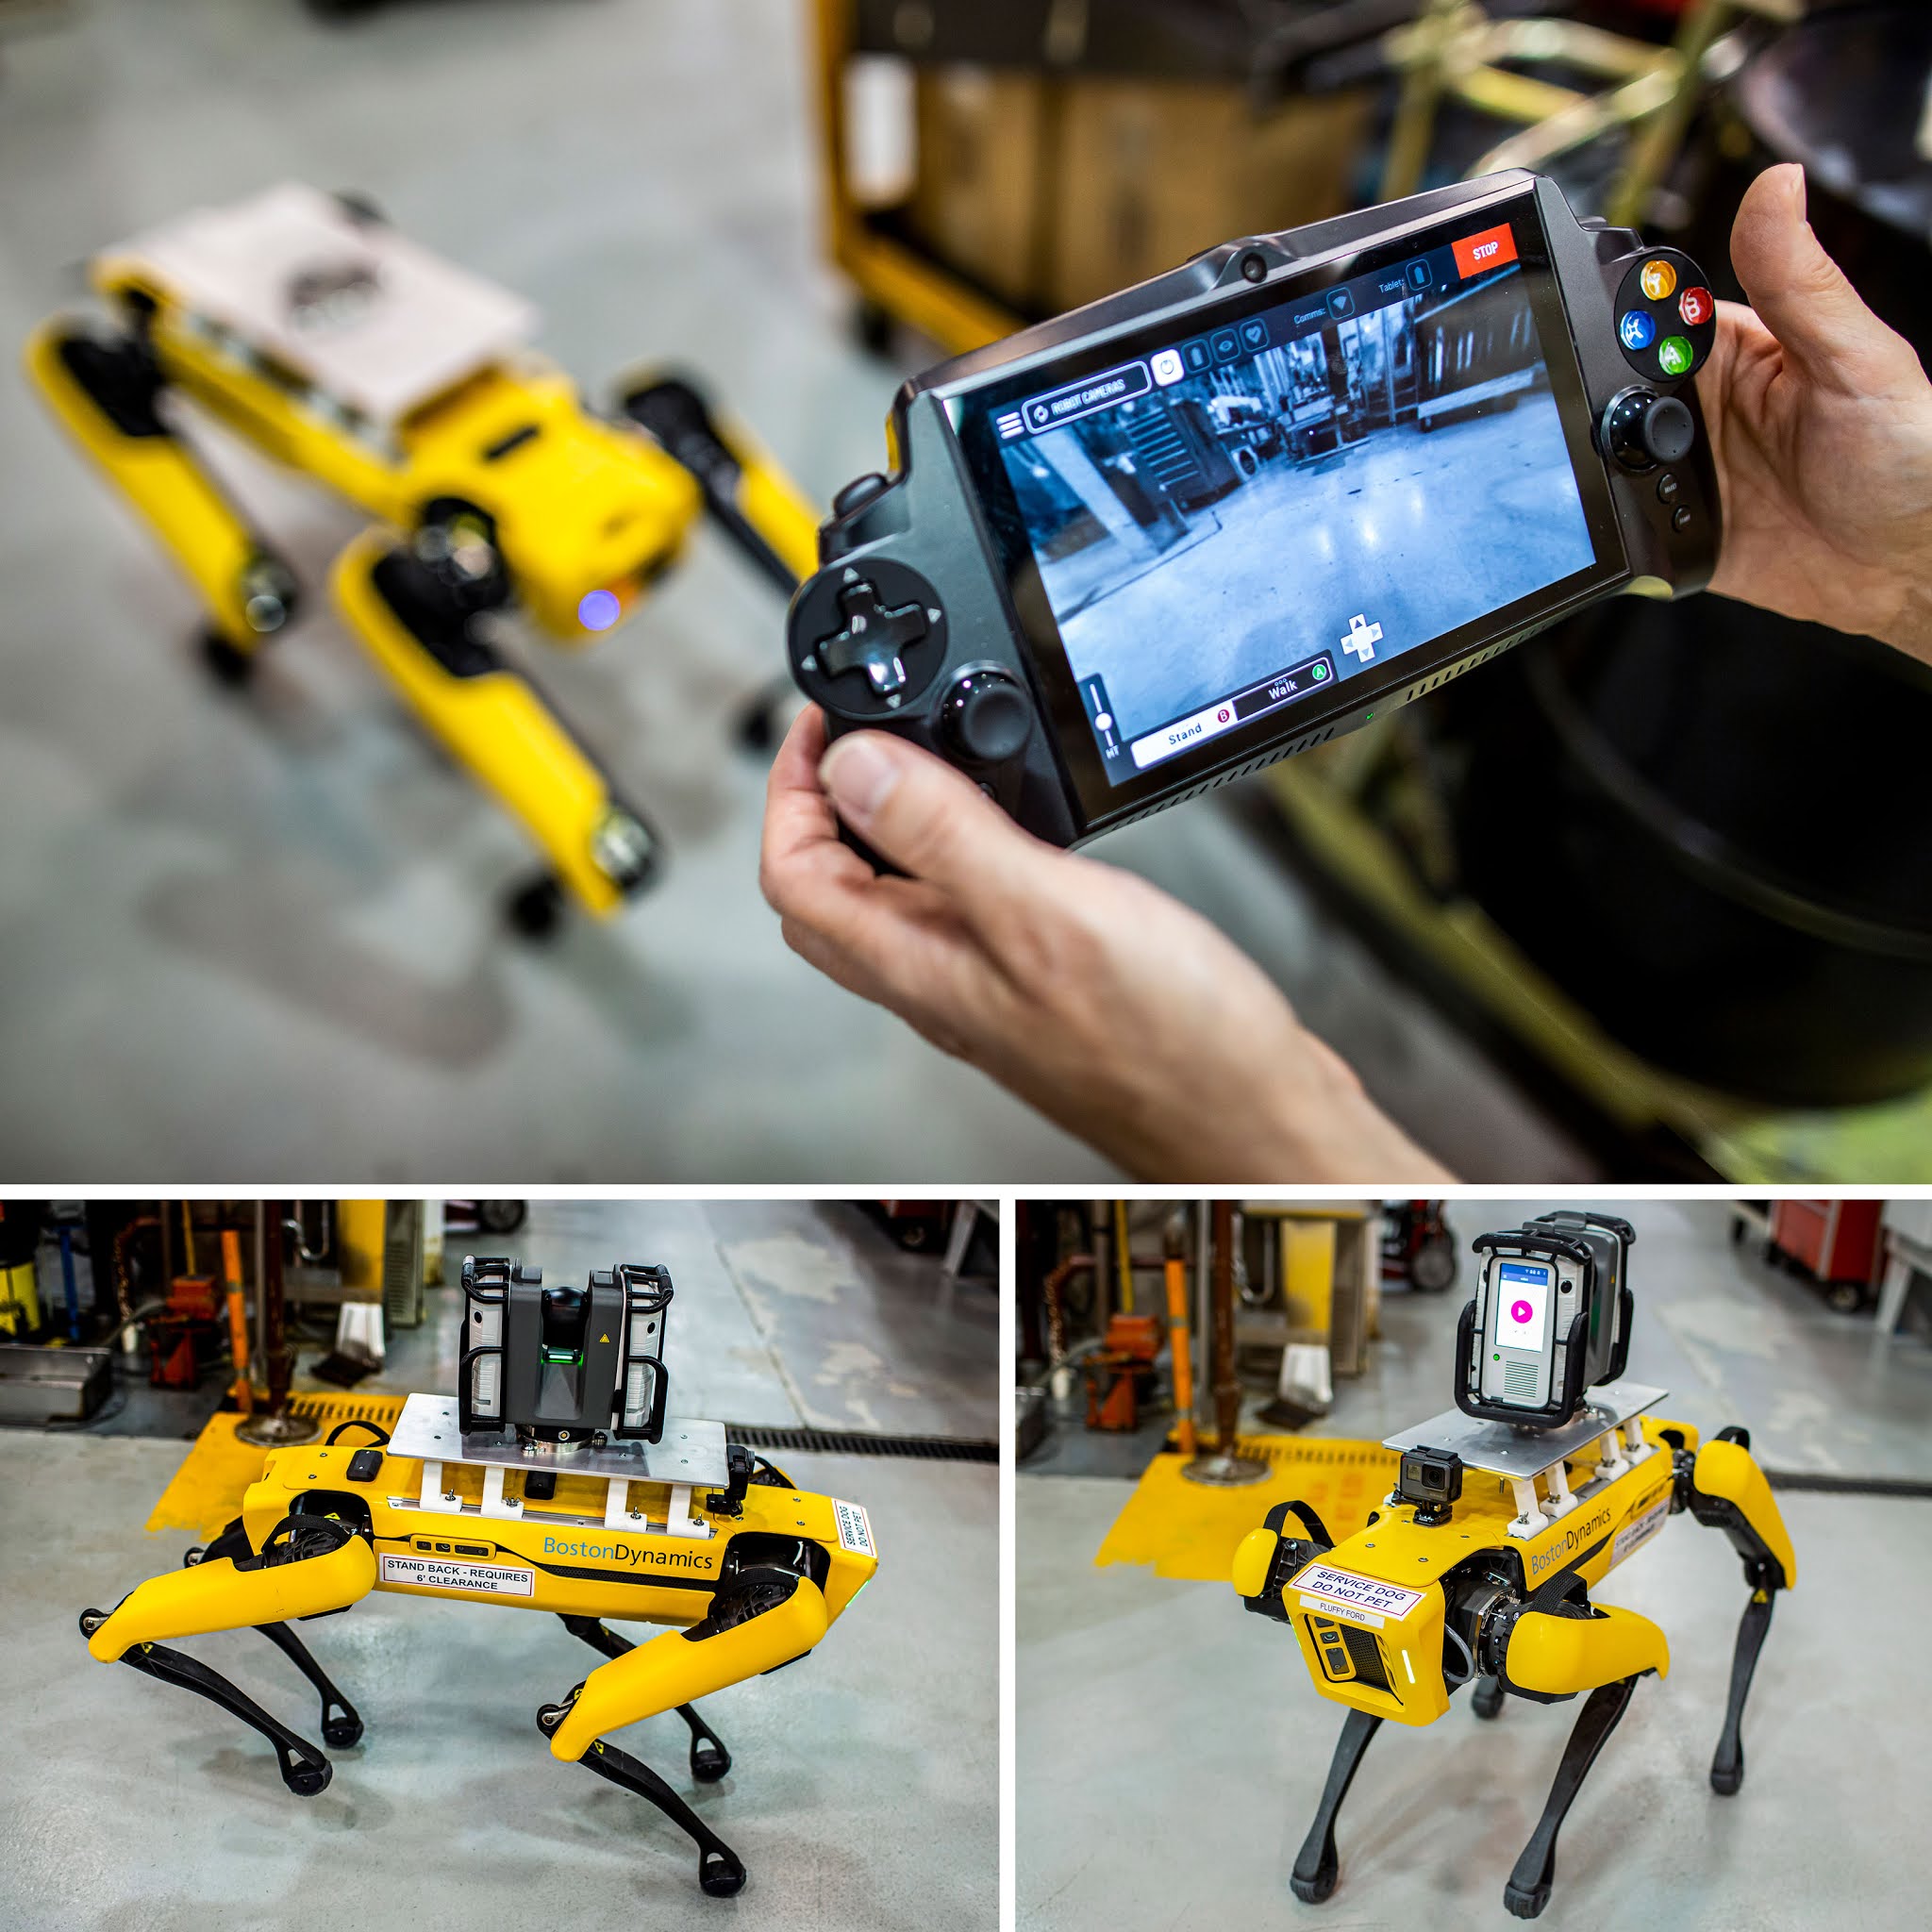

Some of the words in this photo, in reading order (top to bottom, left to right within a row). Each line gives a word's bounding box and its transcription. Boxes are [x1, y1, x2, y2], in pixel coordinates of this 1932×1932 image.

[1473, 242, 1499, 260] STOP
[1293, 306, 1326, 325] Comms:
[1685, 297, 1701, 320] B
[1625, 319, 1643, 341] X
[1664, 344, 1682, 365] A
[1051, 393, 1082, 415] ROBOT
[1081, 378, 1125, 404] CAMERAS
[1268, 680, 1298, 701] Walk
[1168, 723, 1203, 745] Stand
[840, 1506, 850, 1520] DOG
[852, 1510, 861, 1523] PET
[842, 1520, 856, 1545] SERVICE
[855, 1524, 865, 1537] NOT
[858, 1537, 868, 1547] DO
[387, 1559, 425, 1572] STAND
[427, 1564, 460, 1575] BACK
[470, 1569, 528, 1582] REQUIRES
[428, 1575, 498, 1590] CLEARANCE
[1317, 1571, 1374, 1592] SERVICE
[1374, 1587, 1407, 1601] DOG
[1312, 1581, 1333, 1591] DO
[1334, 1587, 1365, 1600] NOT
[1364, 1595, 1392, 1608] PET
[1320, 1603, 1346, 1616] FLUFFY
[1346, 1609, 1366, 1622] FORD
